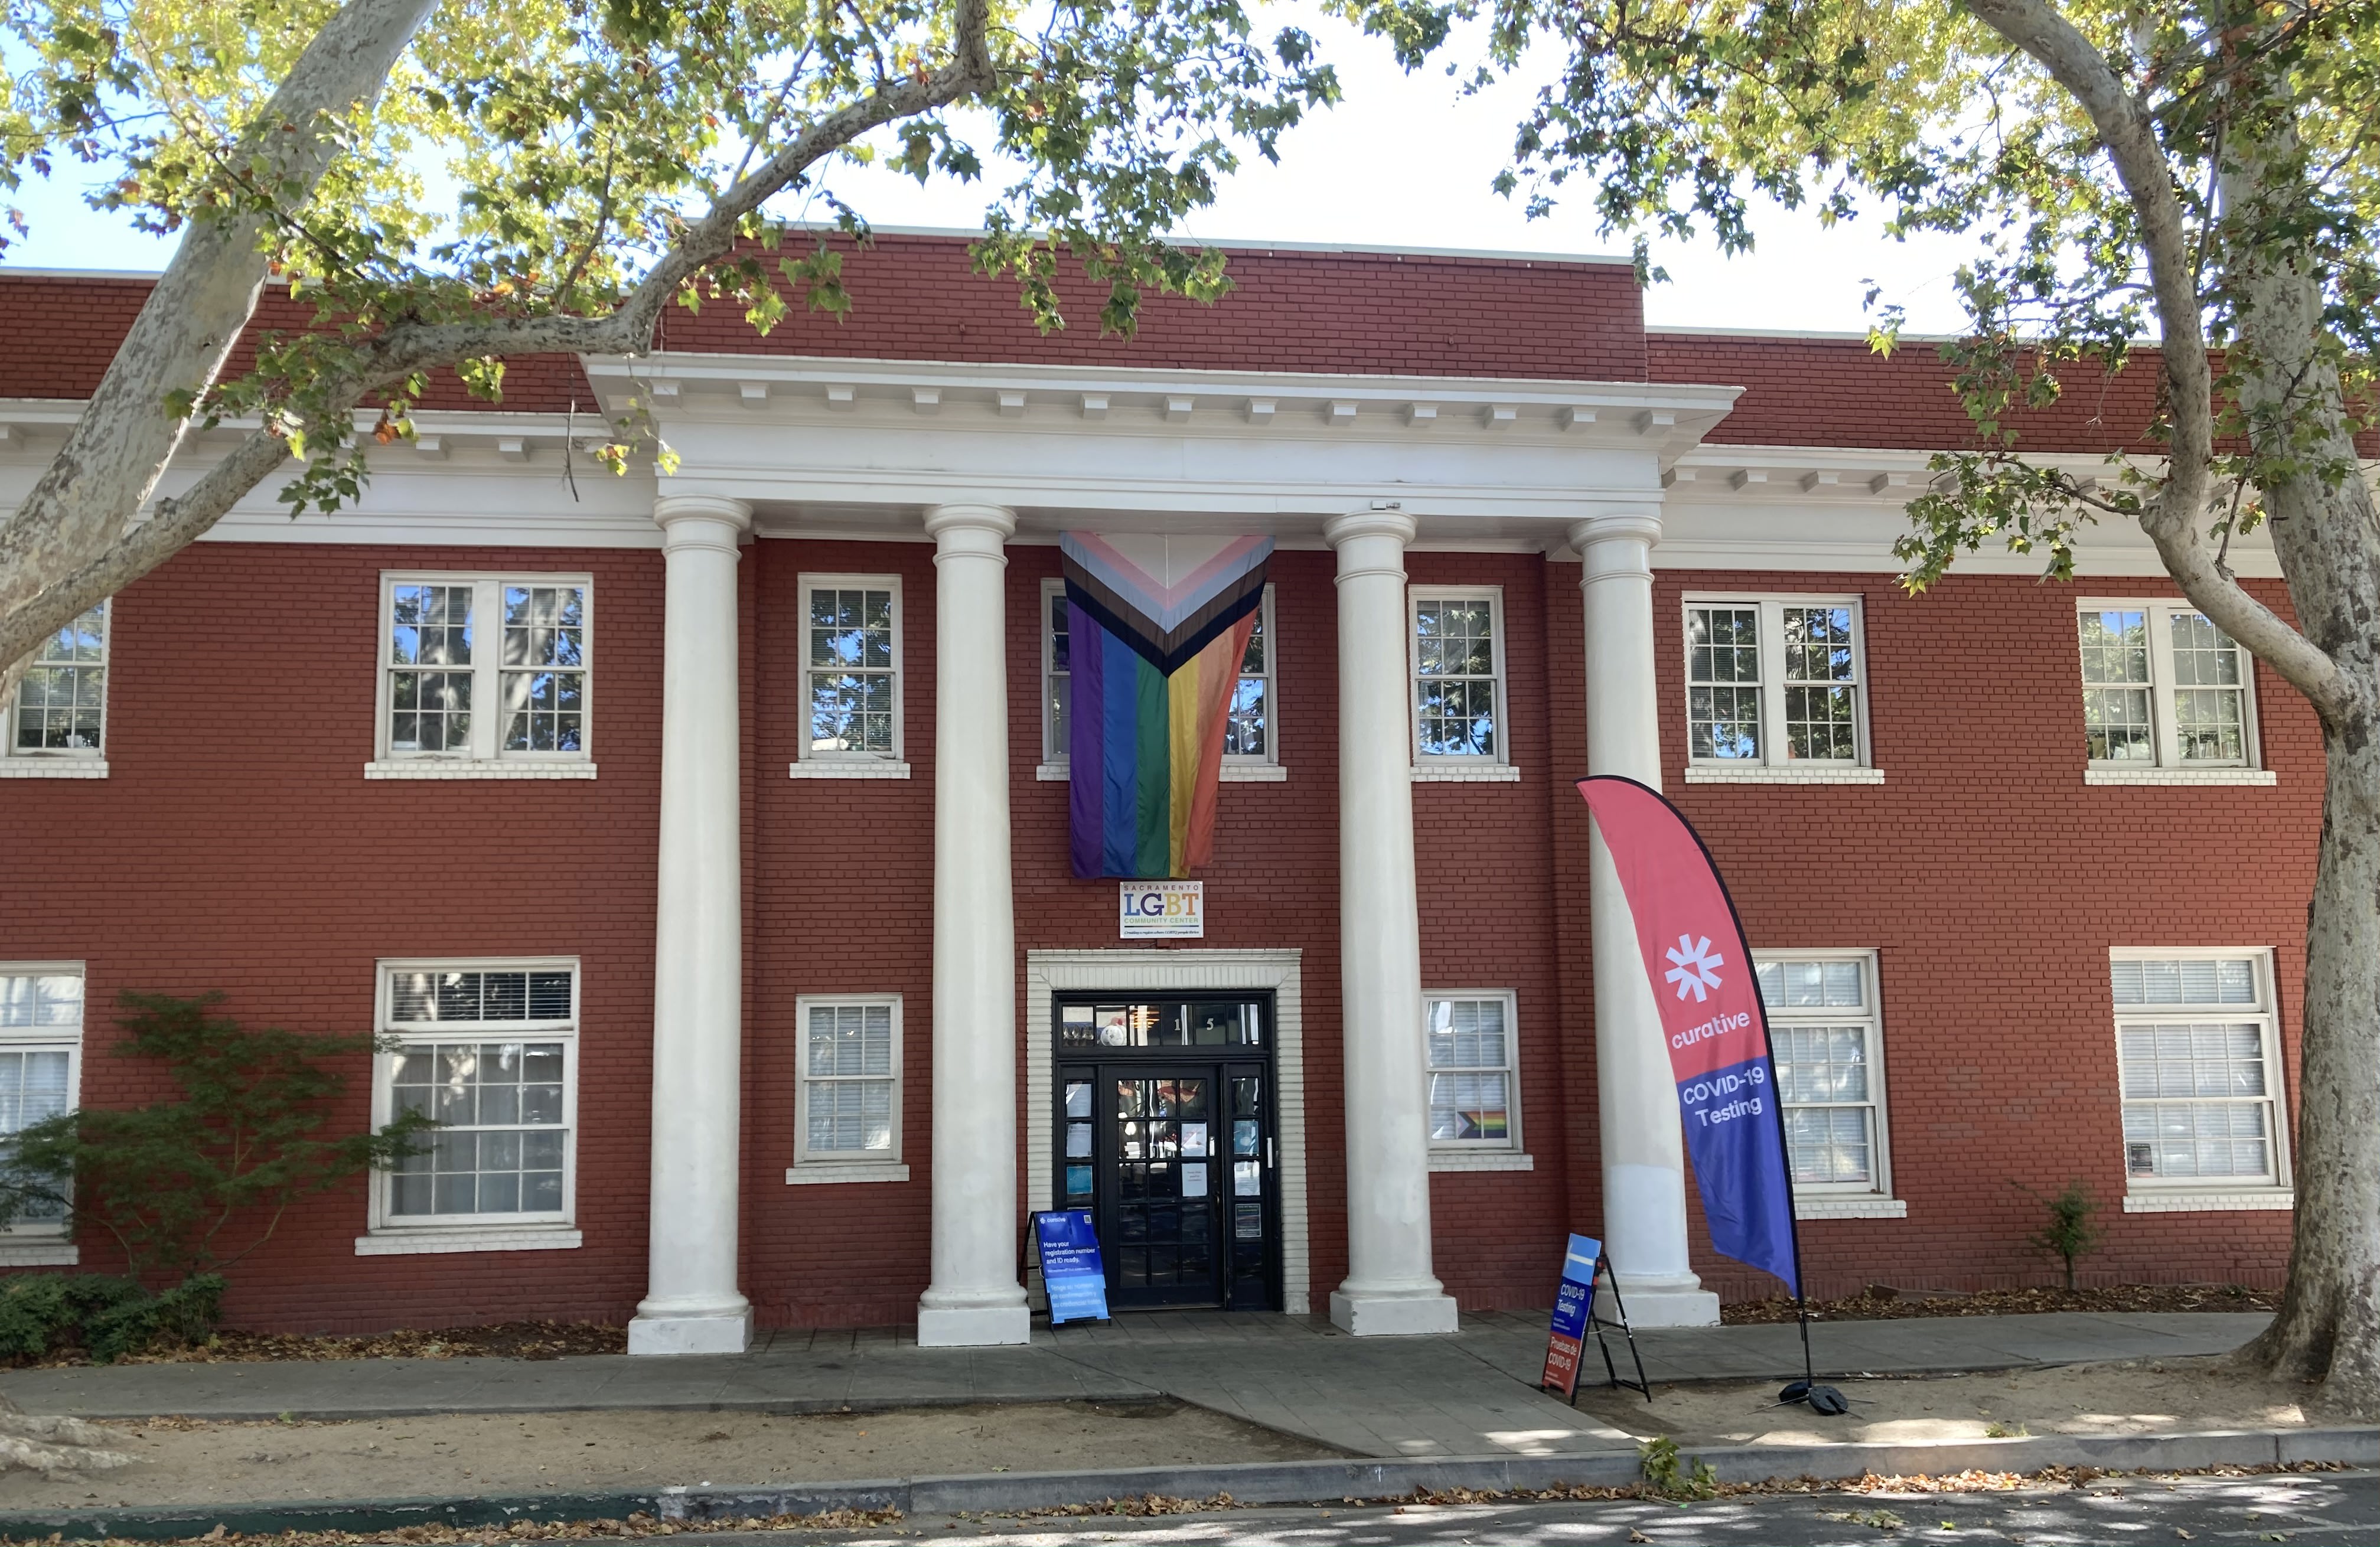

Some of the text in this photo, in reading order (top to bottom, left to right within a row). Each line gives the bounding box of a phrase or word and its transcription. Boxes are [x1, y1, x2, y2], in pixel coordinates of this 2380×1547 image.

[1124, 893, 1199, 916] LGBT
[1174, 1018, 1214, 1031] 1 5
[1671, 1011, 1750, 1049] curative
[1683, 1066, 1765, 1105] COVID-19
[1694, 1096, 1763, 1127] Testing
[1045, 1248, 1075, 1257] registration
[1561, 1284, 1585, 1300] COVID-19
[1557, 1299, 1576, 1317] Testing
[1551, 1337, 1577, 1356] Pruebas de
[1548, 1353, 1571, 1370] COVID-19
